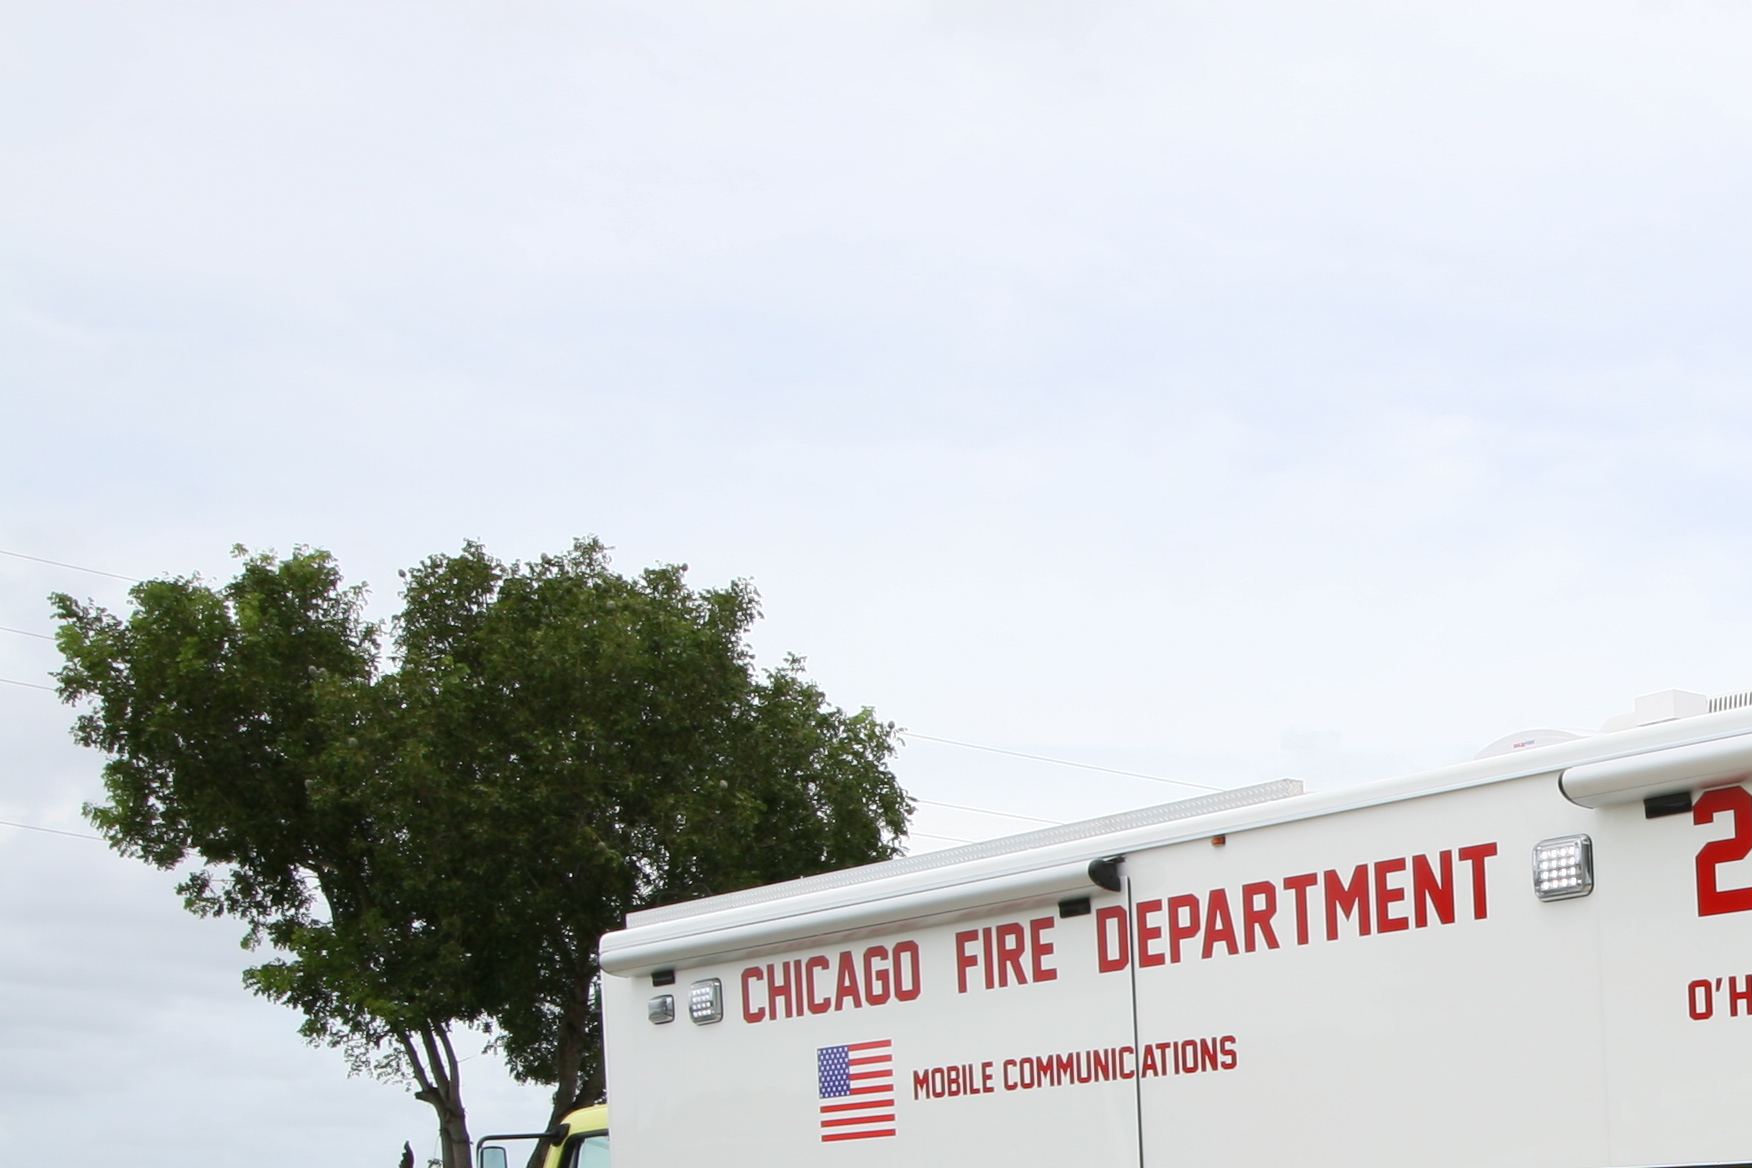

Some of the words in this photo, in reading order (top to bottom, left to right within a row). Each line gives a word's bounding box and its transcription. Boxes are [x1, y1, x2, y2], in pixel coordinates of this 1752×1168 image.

[741, 940, 921, 1024] CHICAGO
[956, 917, 1057, 994] FIRE
[1096, 842, 1498, 974] DEPARTMENT
[913, 1062, 995, 1100] MOBILE
[1003, 1035, 1238, 1091] COMMUNICATIONS
